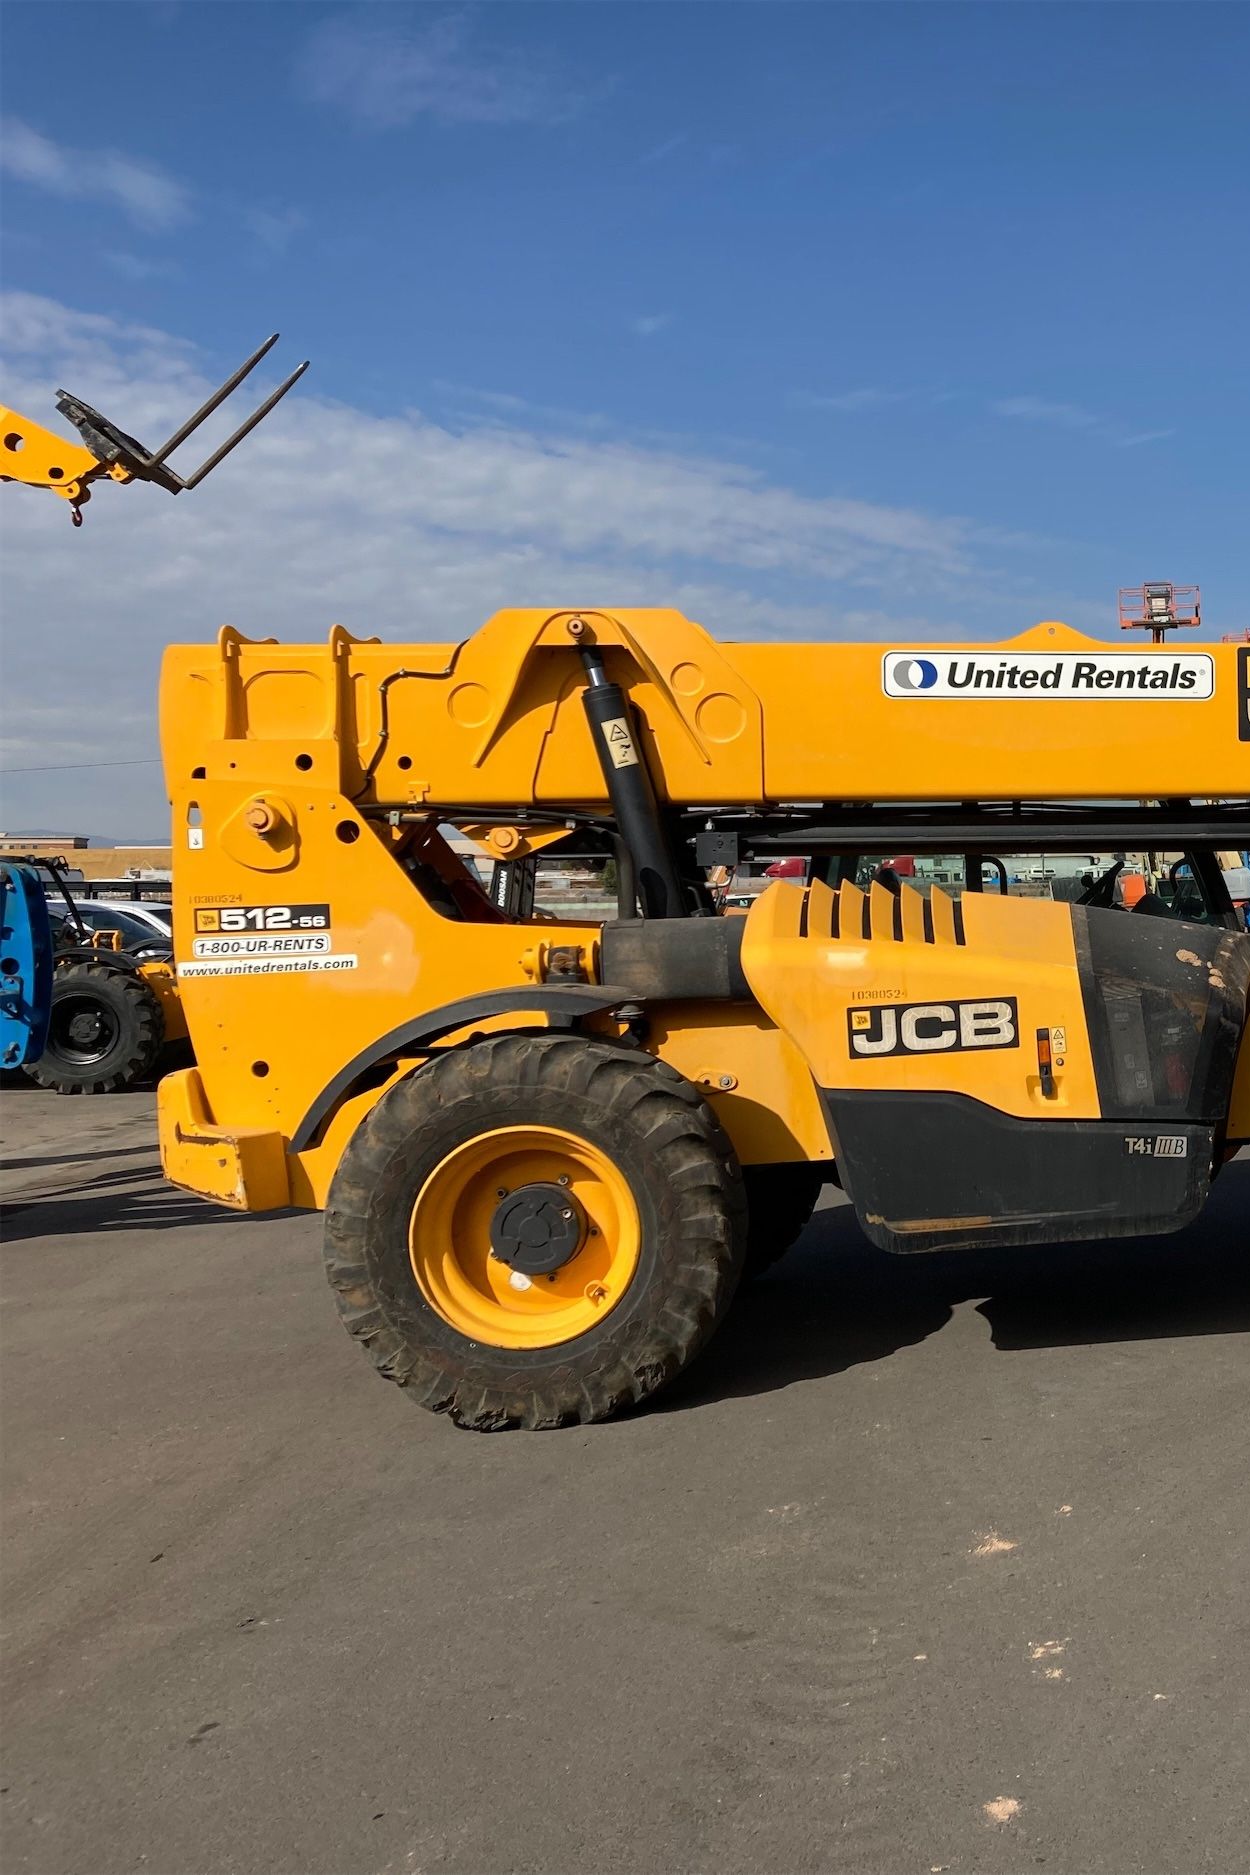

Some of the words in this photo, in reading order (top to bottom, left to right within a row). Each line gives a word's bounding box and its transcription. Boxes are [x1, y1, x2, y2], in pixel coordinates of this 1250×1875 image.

[946, 661, 1065, 690] United
[1071, 661, 1198, 690] Rentals
[497, 869, 508, 908] DOOSAN
[219, 906, 327, 931] 512-56
[197, 937, 326, 955] 1-800-UR-RENTS
[182, 958, 354, 977] www.unitedrentals.com
[851, 1001, 1016, 1055] JCB
